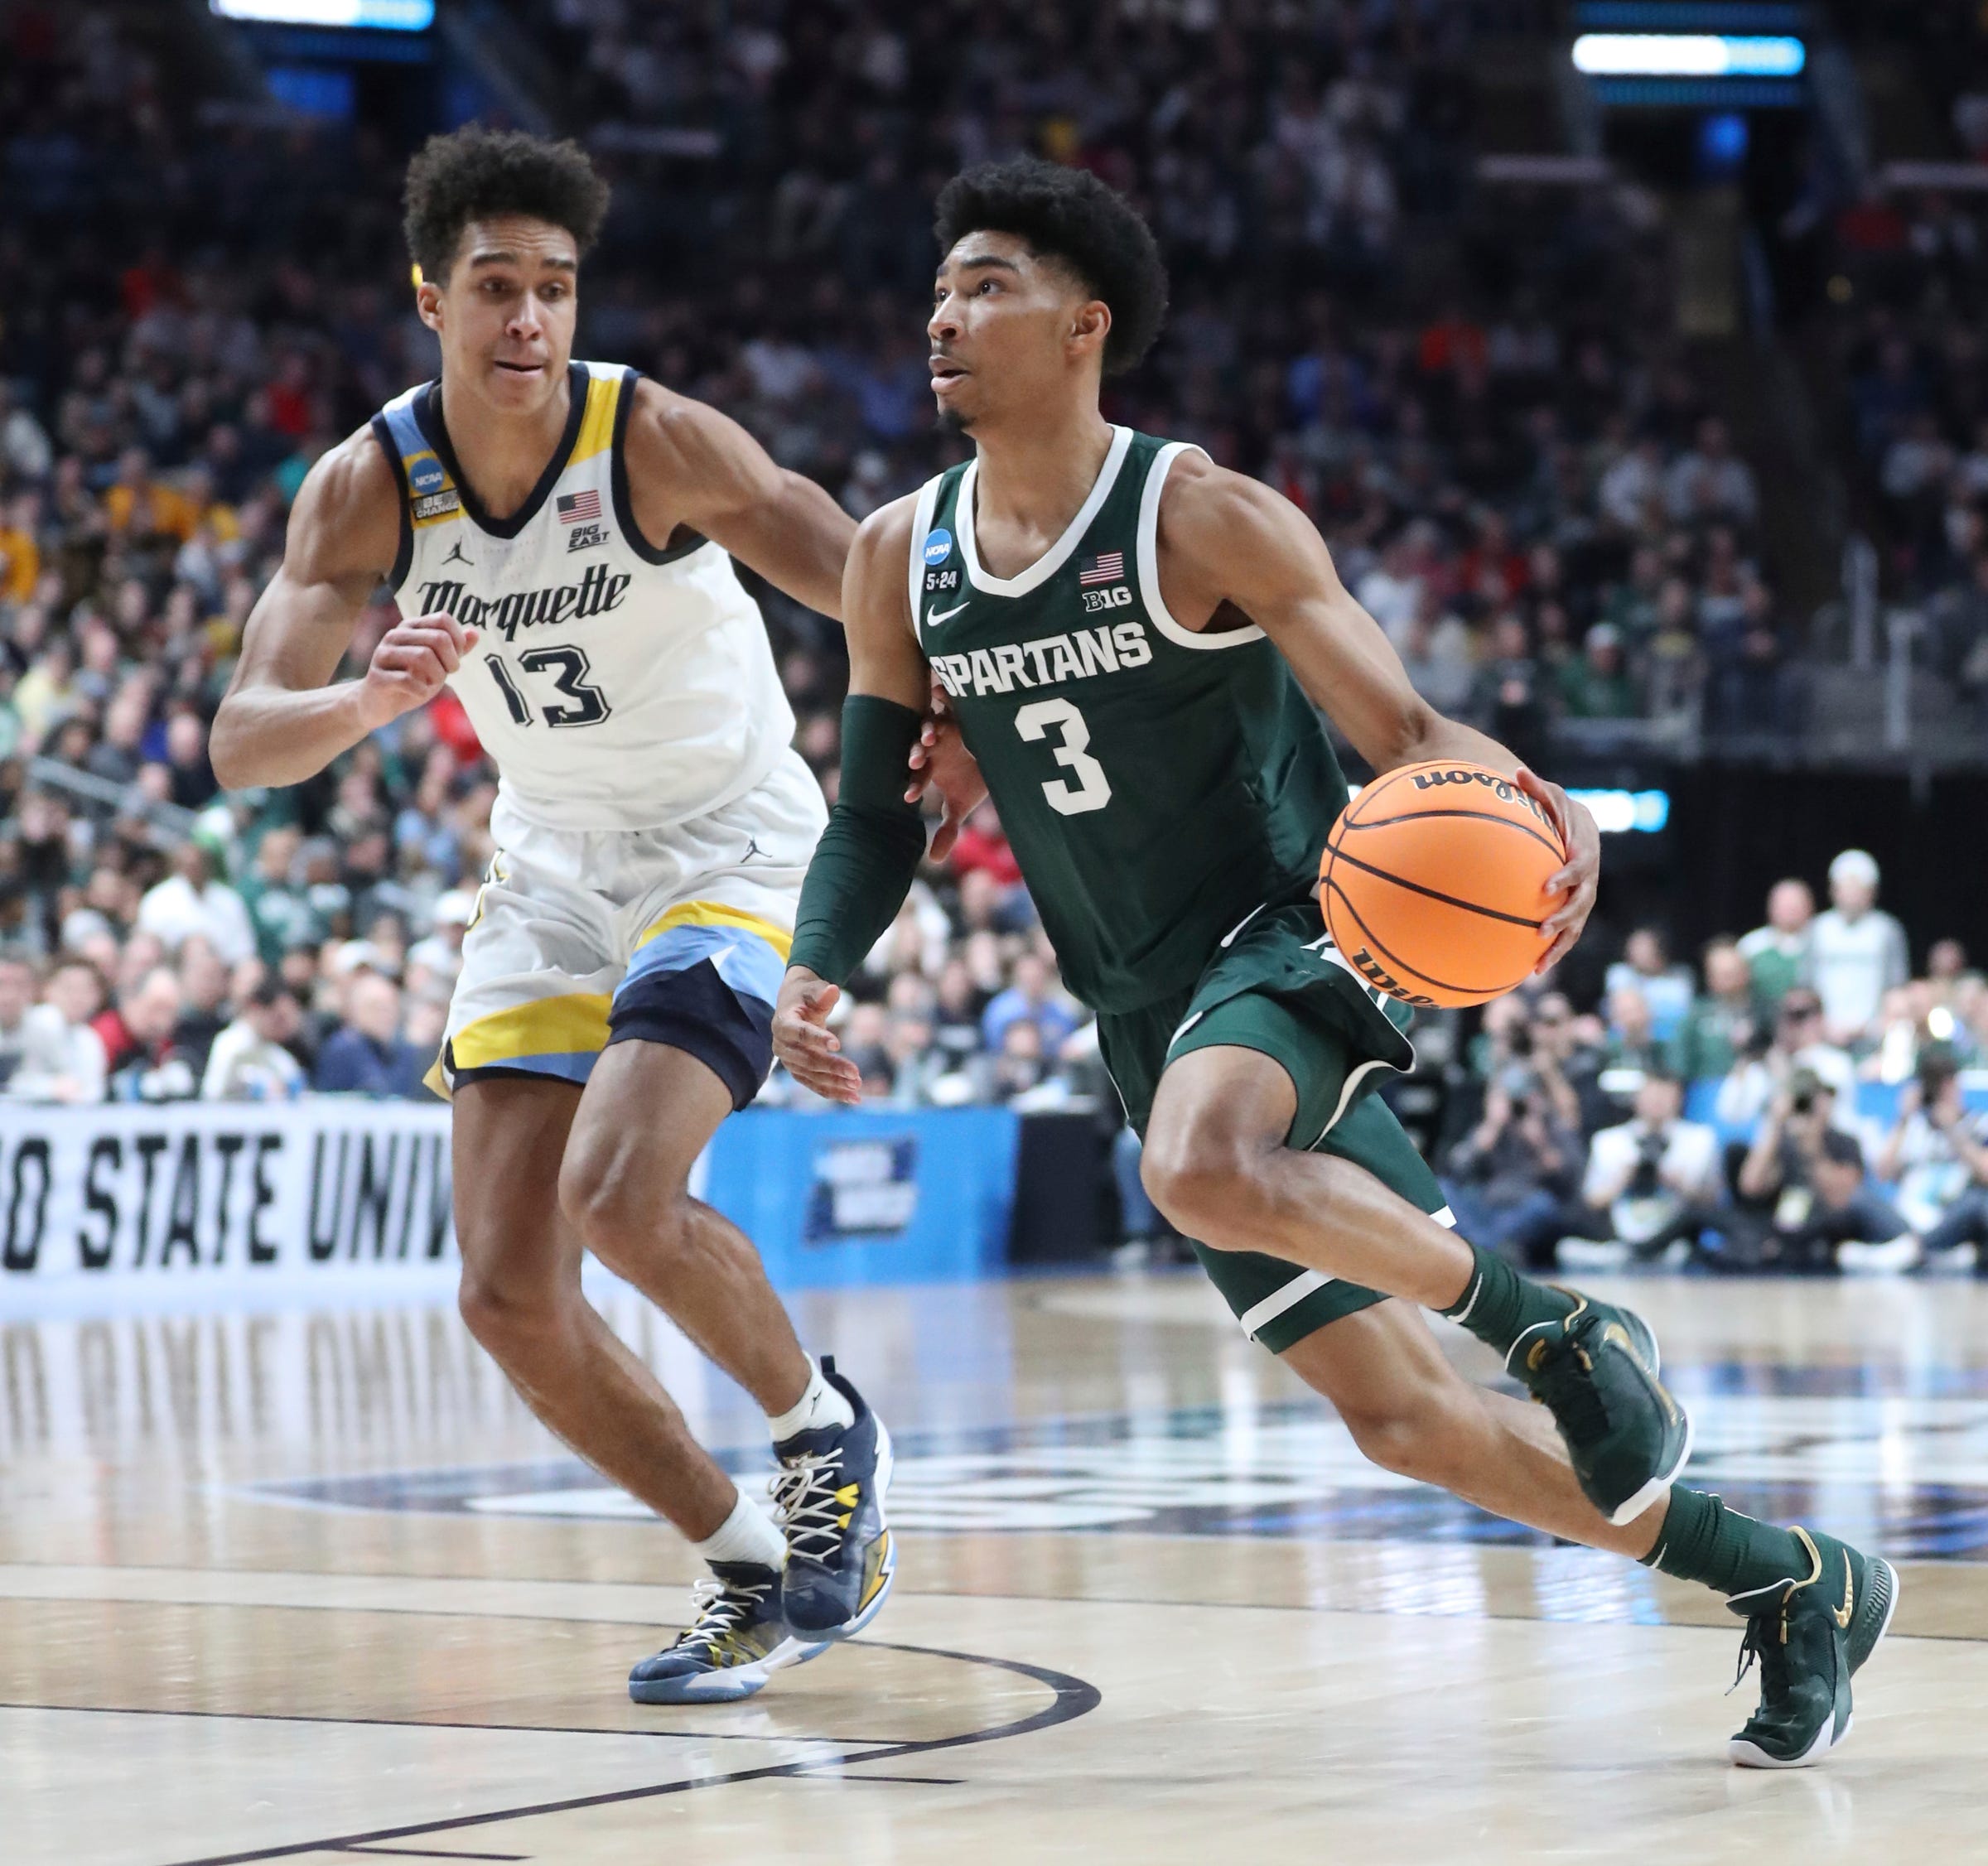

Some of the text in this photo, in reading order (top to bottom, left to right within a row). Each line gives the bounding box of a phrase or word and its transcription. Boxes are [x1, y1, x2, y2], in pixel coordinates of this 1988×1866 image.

[415, 472, 443, 487] NCAA
[568, 531, 610, 548] EAST
[571, 523, 600, 538] BIG
[924, 542, 951, 558] NCAA
[417, 563, 632, 642] Marquette
[484, 644, 613, 729] 13
[929, 621, 1153, 697] SPARTANS
[1014, 697, 1112, 816] 3
[78, 1132, 284, 1270] STATE
